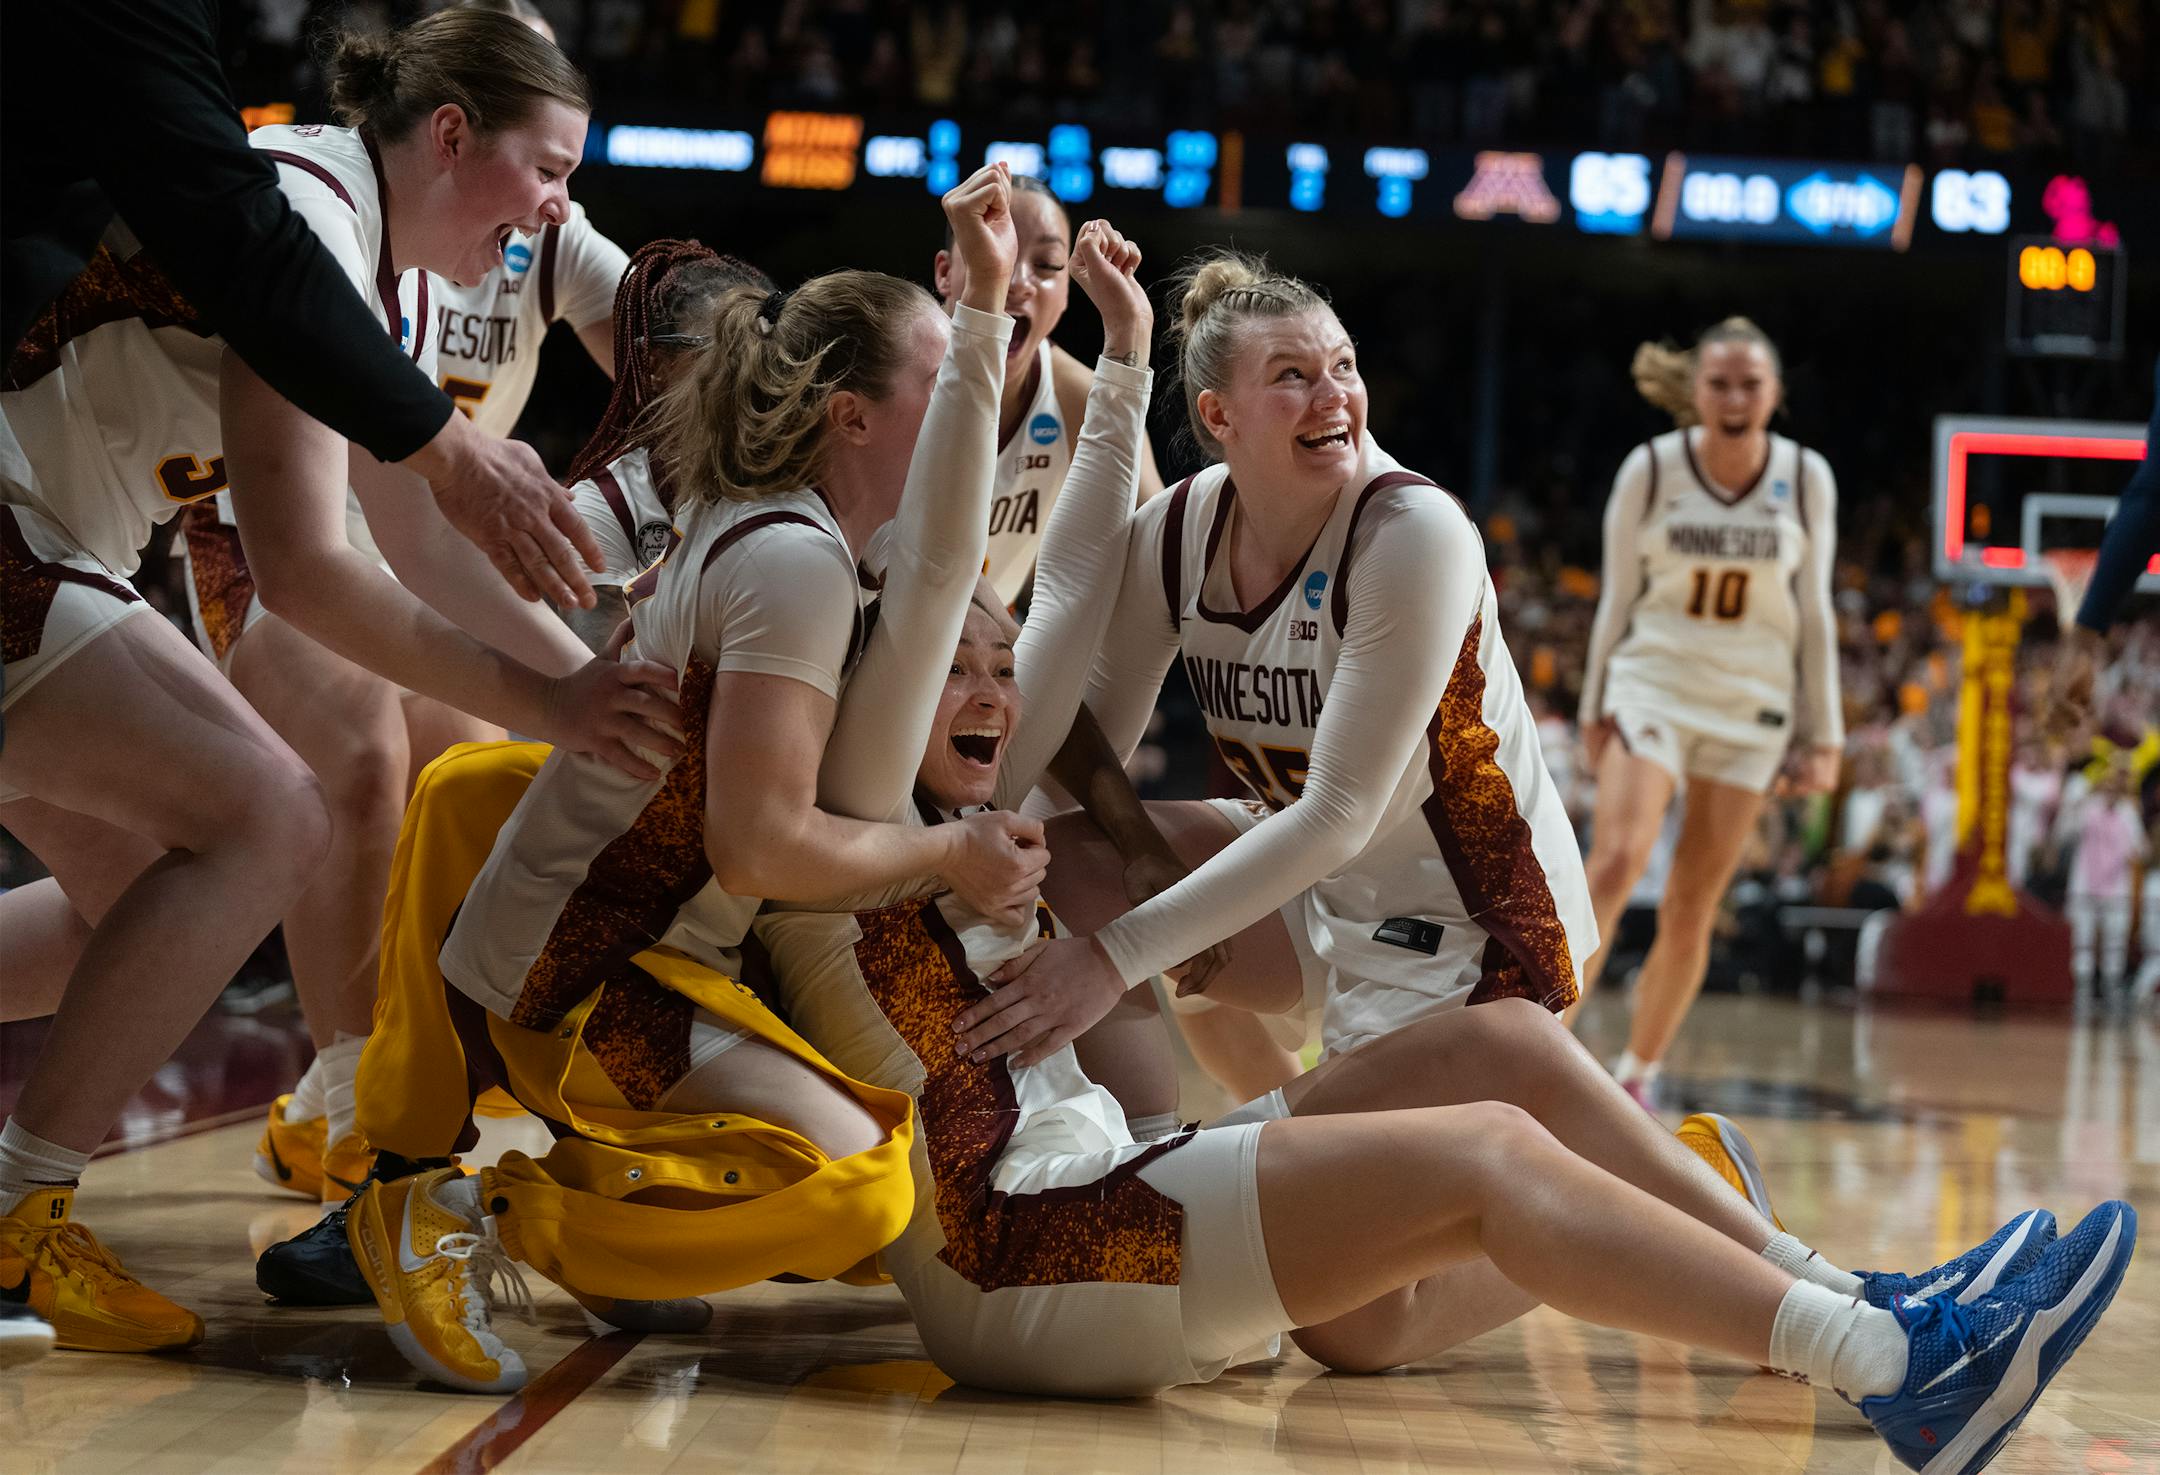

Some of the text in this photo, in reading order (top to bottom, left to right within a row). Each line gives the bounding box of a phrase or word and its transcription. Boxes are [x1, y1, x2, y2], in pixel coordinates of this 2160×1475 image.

[1571, 152, 1651, 217] 65
[1932, 169, 2011, 234] 63
[1667, 524, 1781, 560] MINNESOTA
[1687, 566, 1751, 622] 10
